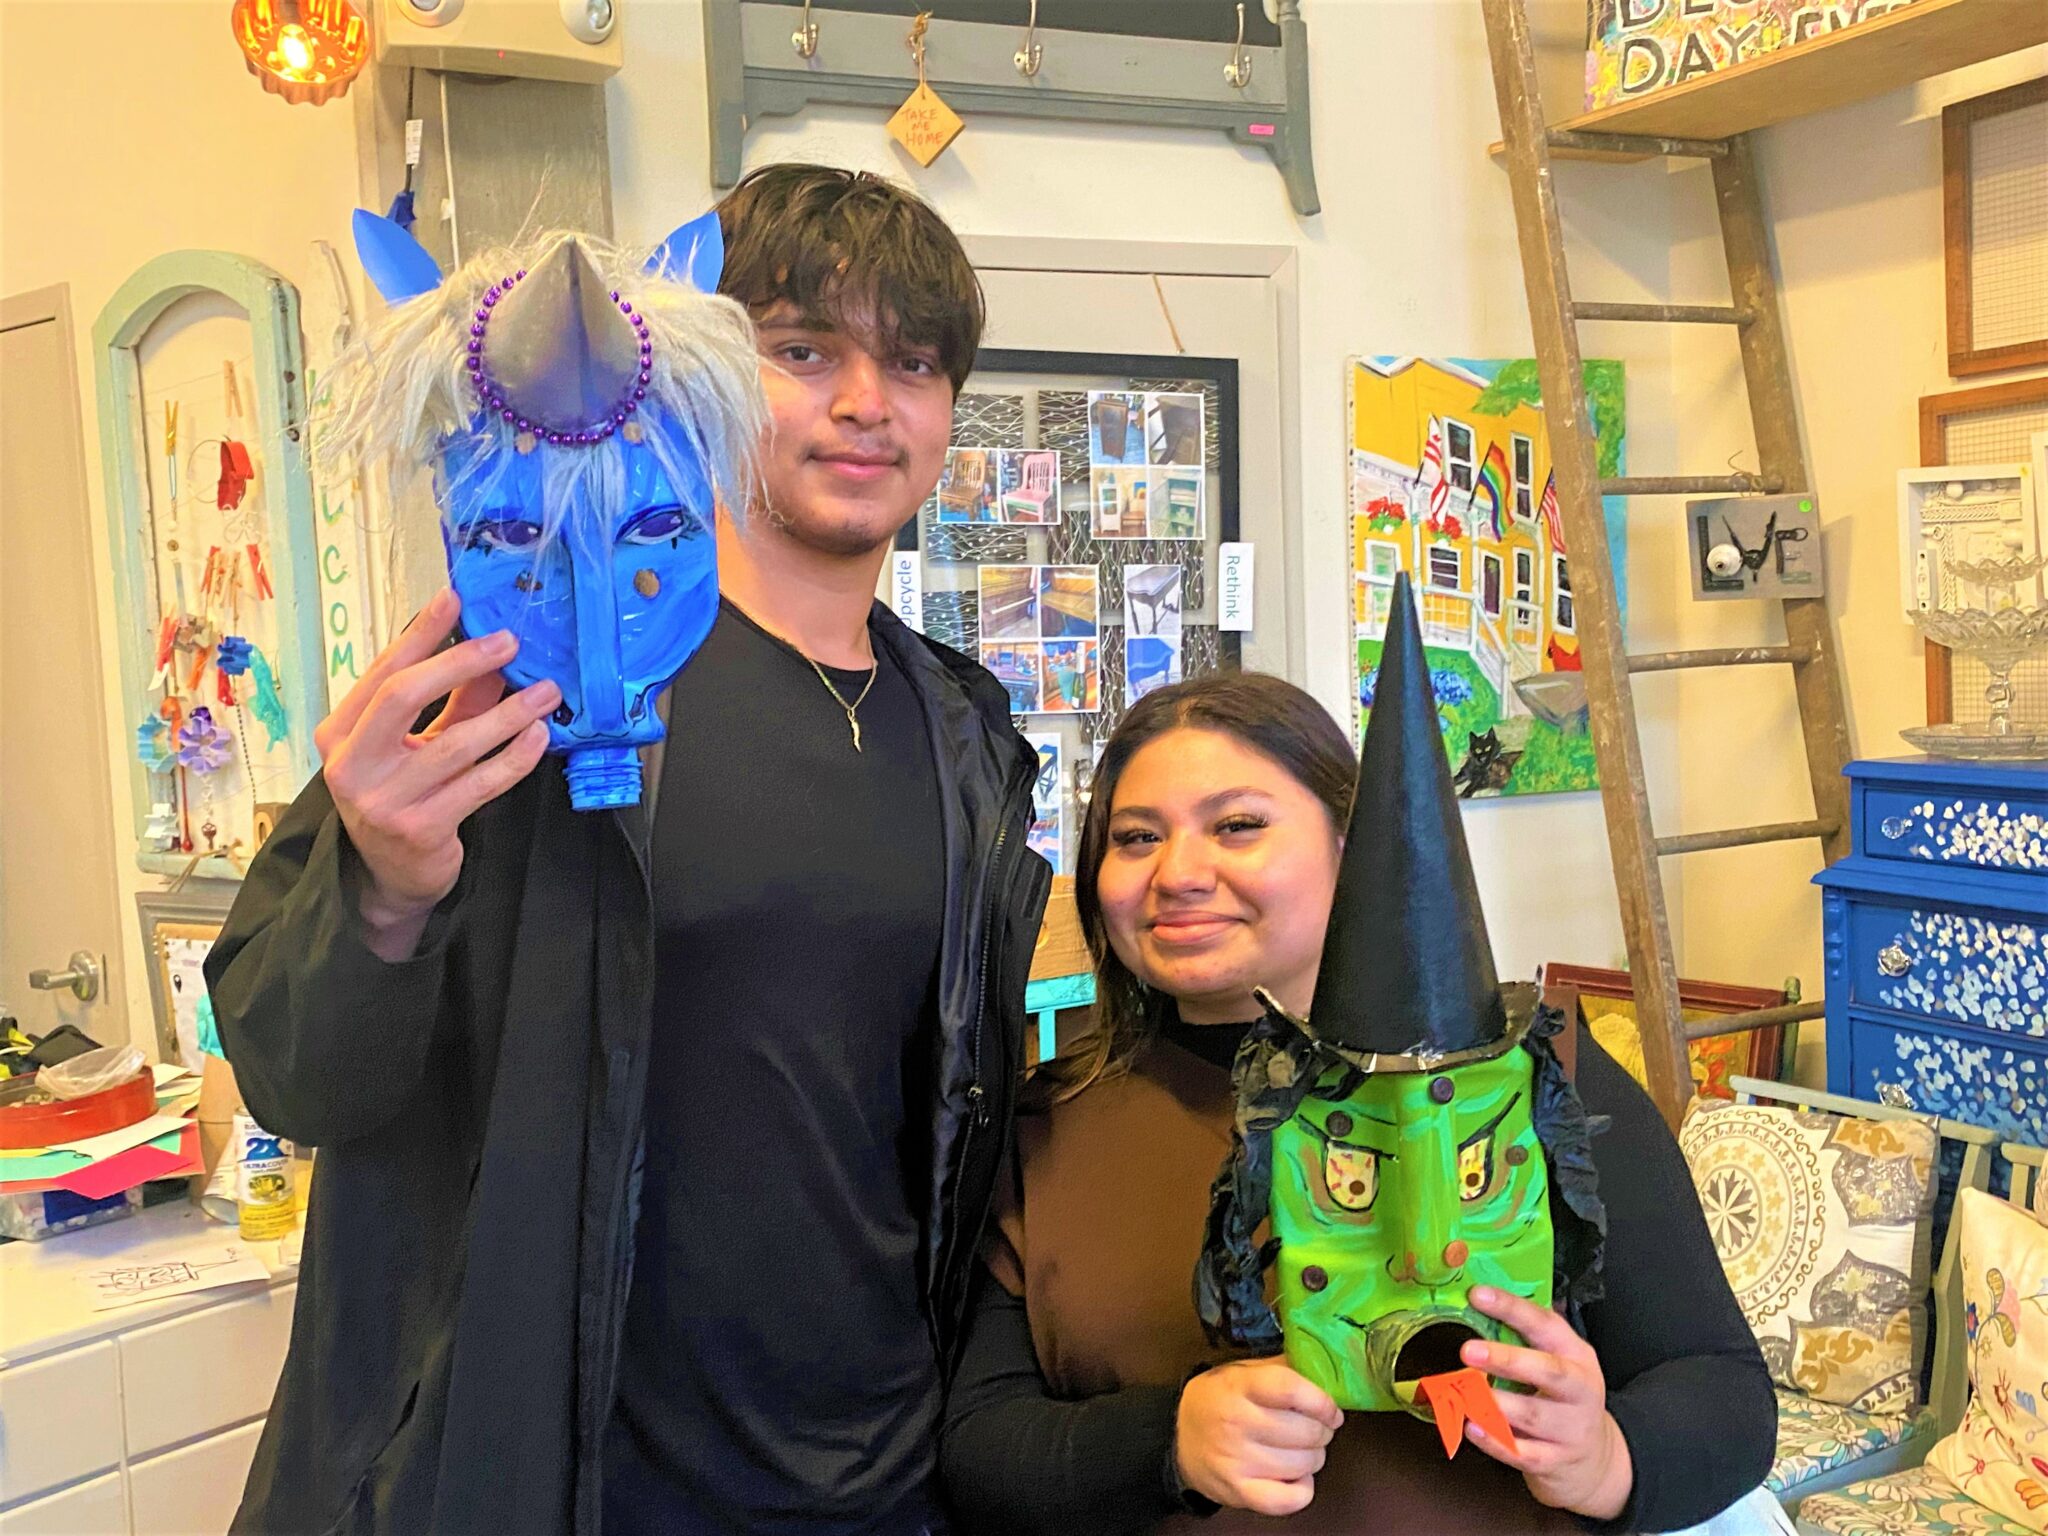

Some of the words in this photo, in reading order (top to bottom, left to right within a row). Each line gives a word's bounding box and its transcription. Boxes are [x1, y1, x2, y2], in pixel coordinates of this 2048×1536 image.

[1621, 23, 1759, 93] DAY
[901, 108, 938, 120] TAKE
[912, 121, 930, 131] ME
[905, 131, 944, 146] HOME
[1226, 555, 1241, 618] Rethink
[246, 1137, 285, 1161] 2X
